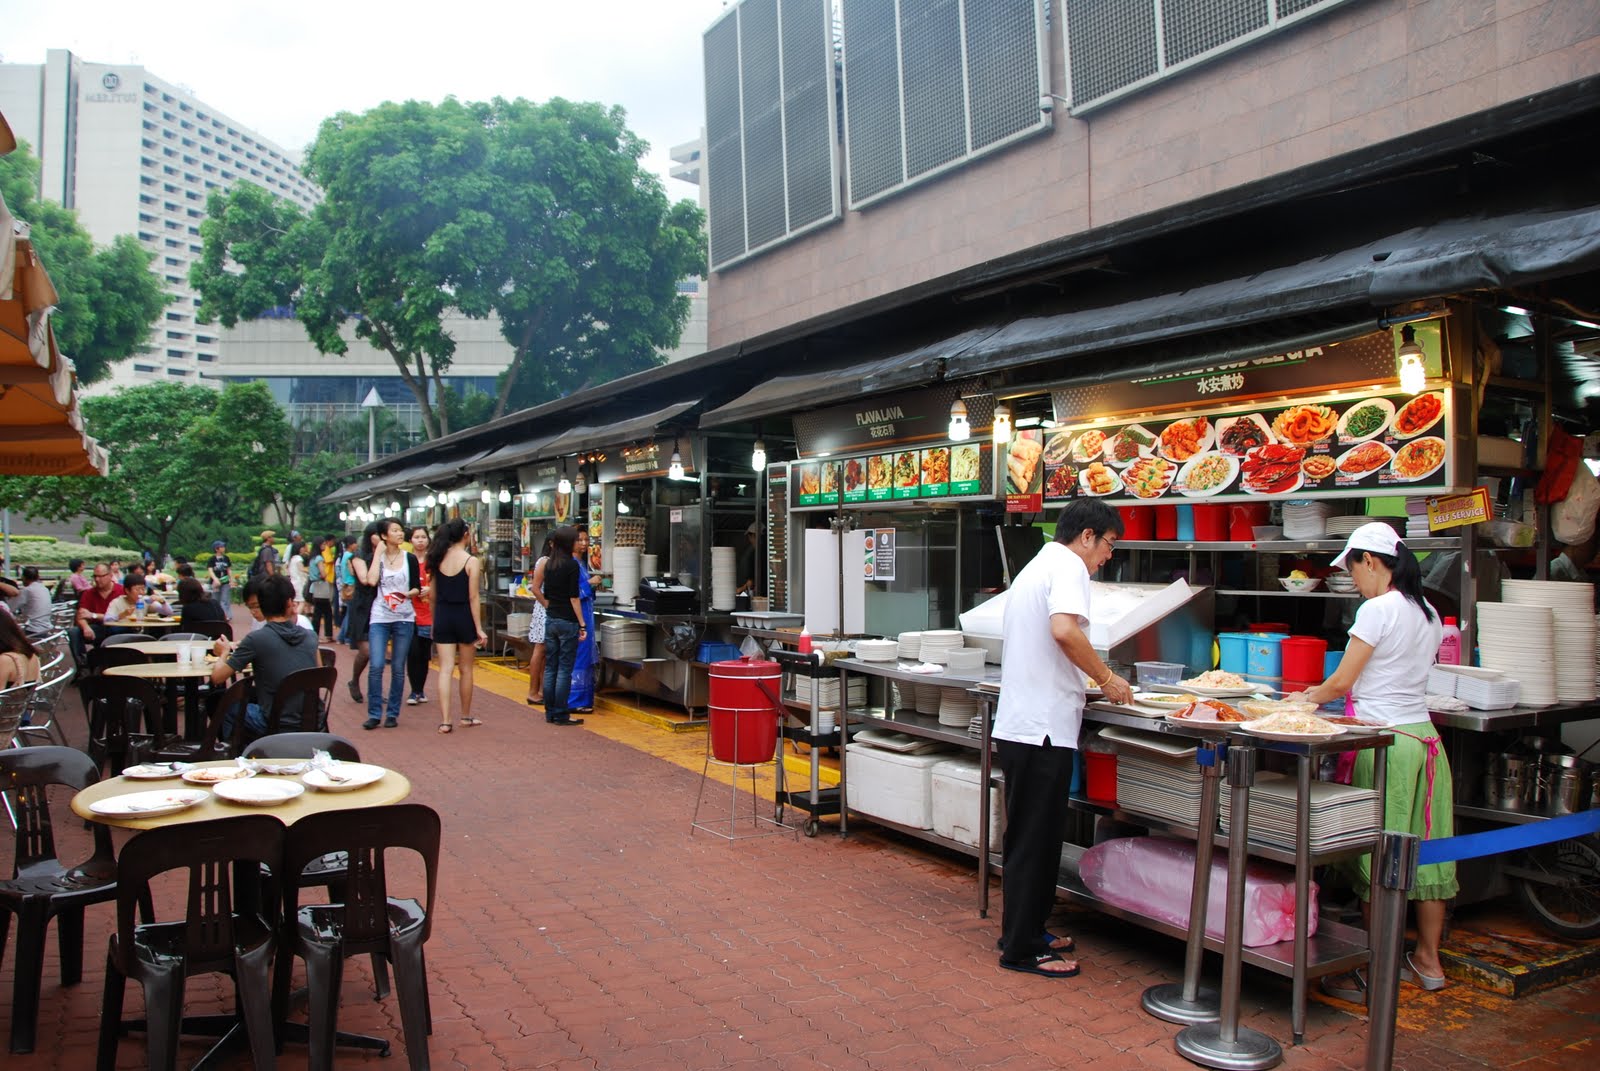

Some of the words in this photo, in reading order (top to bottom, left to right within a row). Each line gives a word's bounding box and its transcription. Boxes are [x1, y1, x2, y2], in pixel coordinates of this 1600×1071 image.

[1197, 372, 1244, 394] 水安煮炒
[1434, 513, 1450, 524] SELF
[1452, 508, 1485, 520] SERVICE
